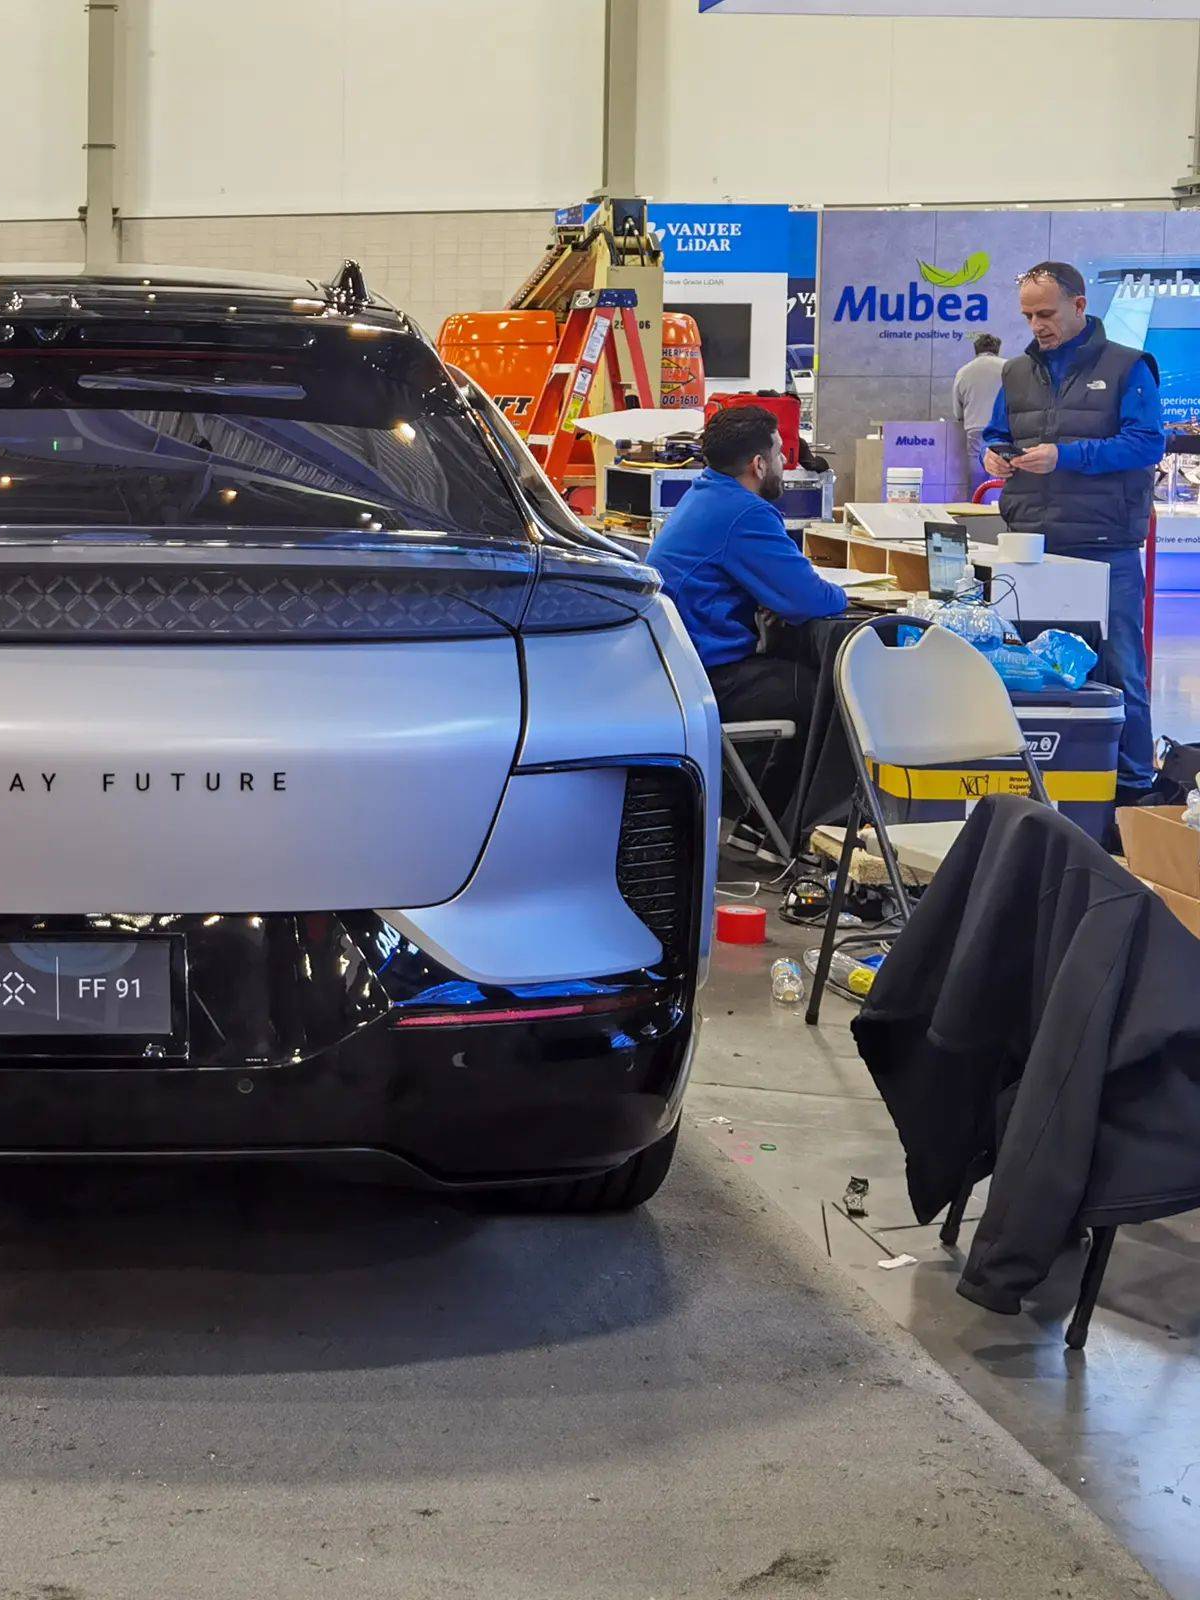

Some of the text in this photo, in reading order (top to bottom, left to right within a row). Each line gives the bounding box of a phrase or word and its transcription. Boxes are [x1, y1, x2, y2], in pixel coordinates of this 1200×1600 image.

[666, 223, 742, 236] VANJEE
[677, 238, 732, 252] LiDAR
[1118, 270, 1200, 299] Mub
[833, 281, 988, 322] Mubea
[879, 330, 912, 339] climate
[914, 330, 950, 340] positive
[952, 330, 964, 340] by
[1190, 406, 1200, 415] to
[895, 435, 935, 446] Mubea
[102, 772, 287, 792] FUTURE
[78, 978, 141, 998] FF 91
